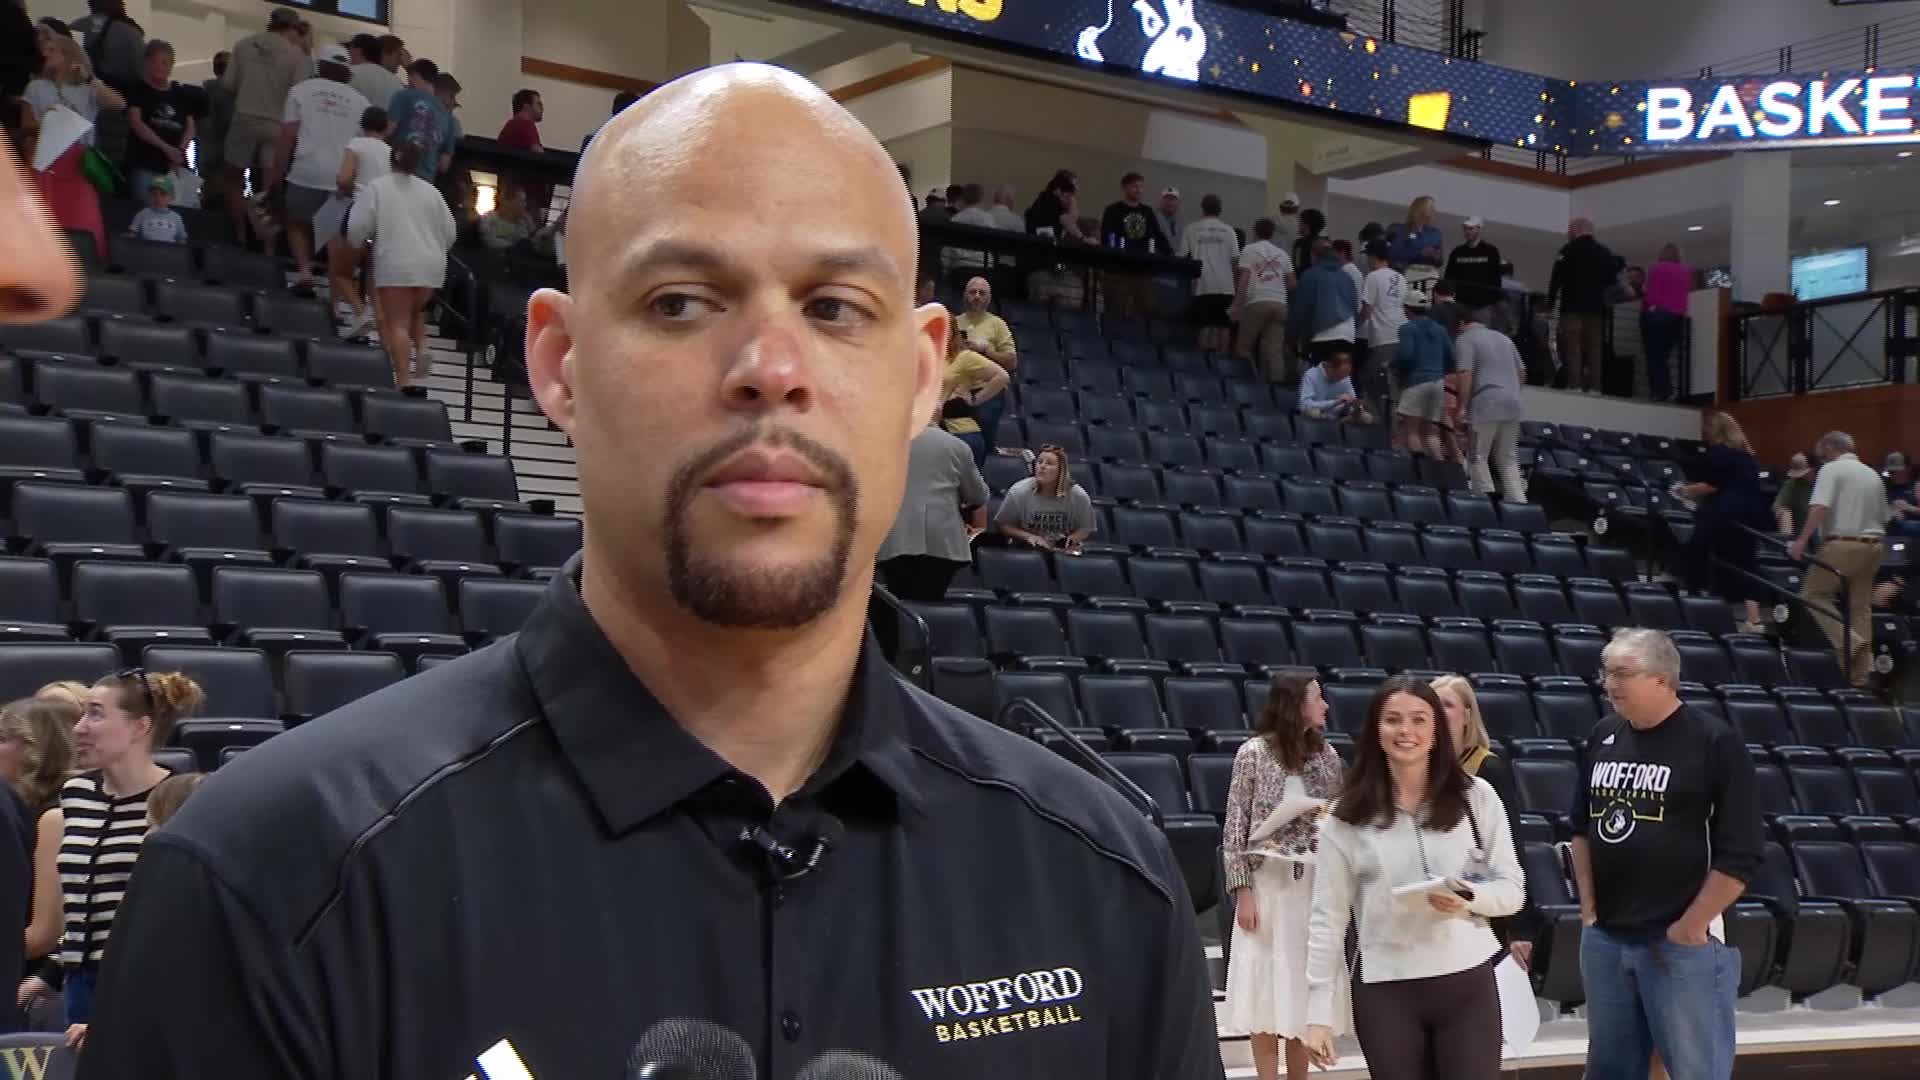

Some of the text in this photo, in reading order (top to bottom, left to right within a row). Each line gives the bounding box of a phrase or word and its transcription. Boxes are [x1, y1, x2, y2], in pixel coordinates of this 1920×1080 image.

[1646, 75, 1920, 141] BASKE
[1591, 761, 1672, 792] WOFFORD
[910, 967, 1084, 1020] WOFFORD
[934, 1004, 1082, 1043] BASKETBALL
[2, 1045, 56, 1080] W
